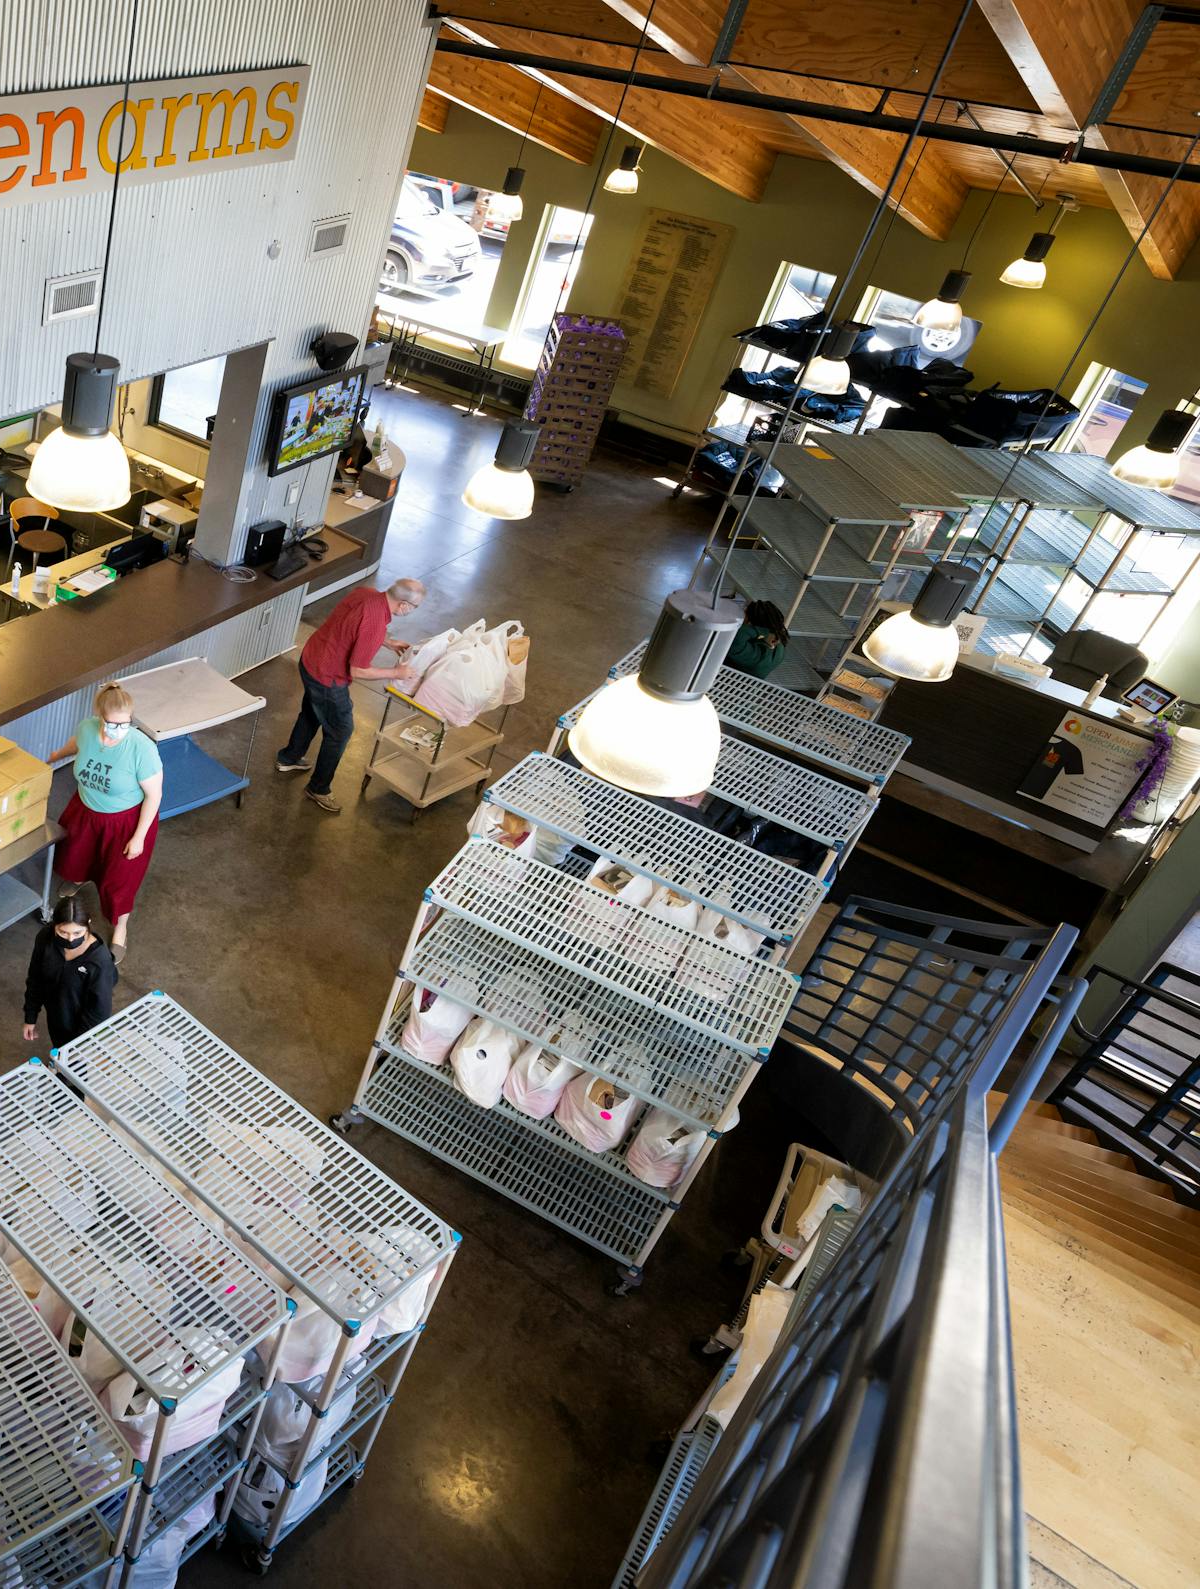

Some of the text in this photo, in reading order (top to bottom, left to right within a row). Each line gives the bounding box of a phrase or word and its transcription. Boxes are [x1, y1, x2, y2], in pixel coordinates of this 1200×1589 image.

[97, 80, 300, 175] arms
[1085, 725, 1112, 739] OPEN
[86, 758, 113, 776] EAT
[78, 769, 111, 789] MORE
